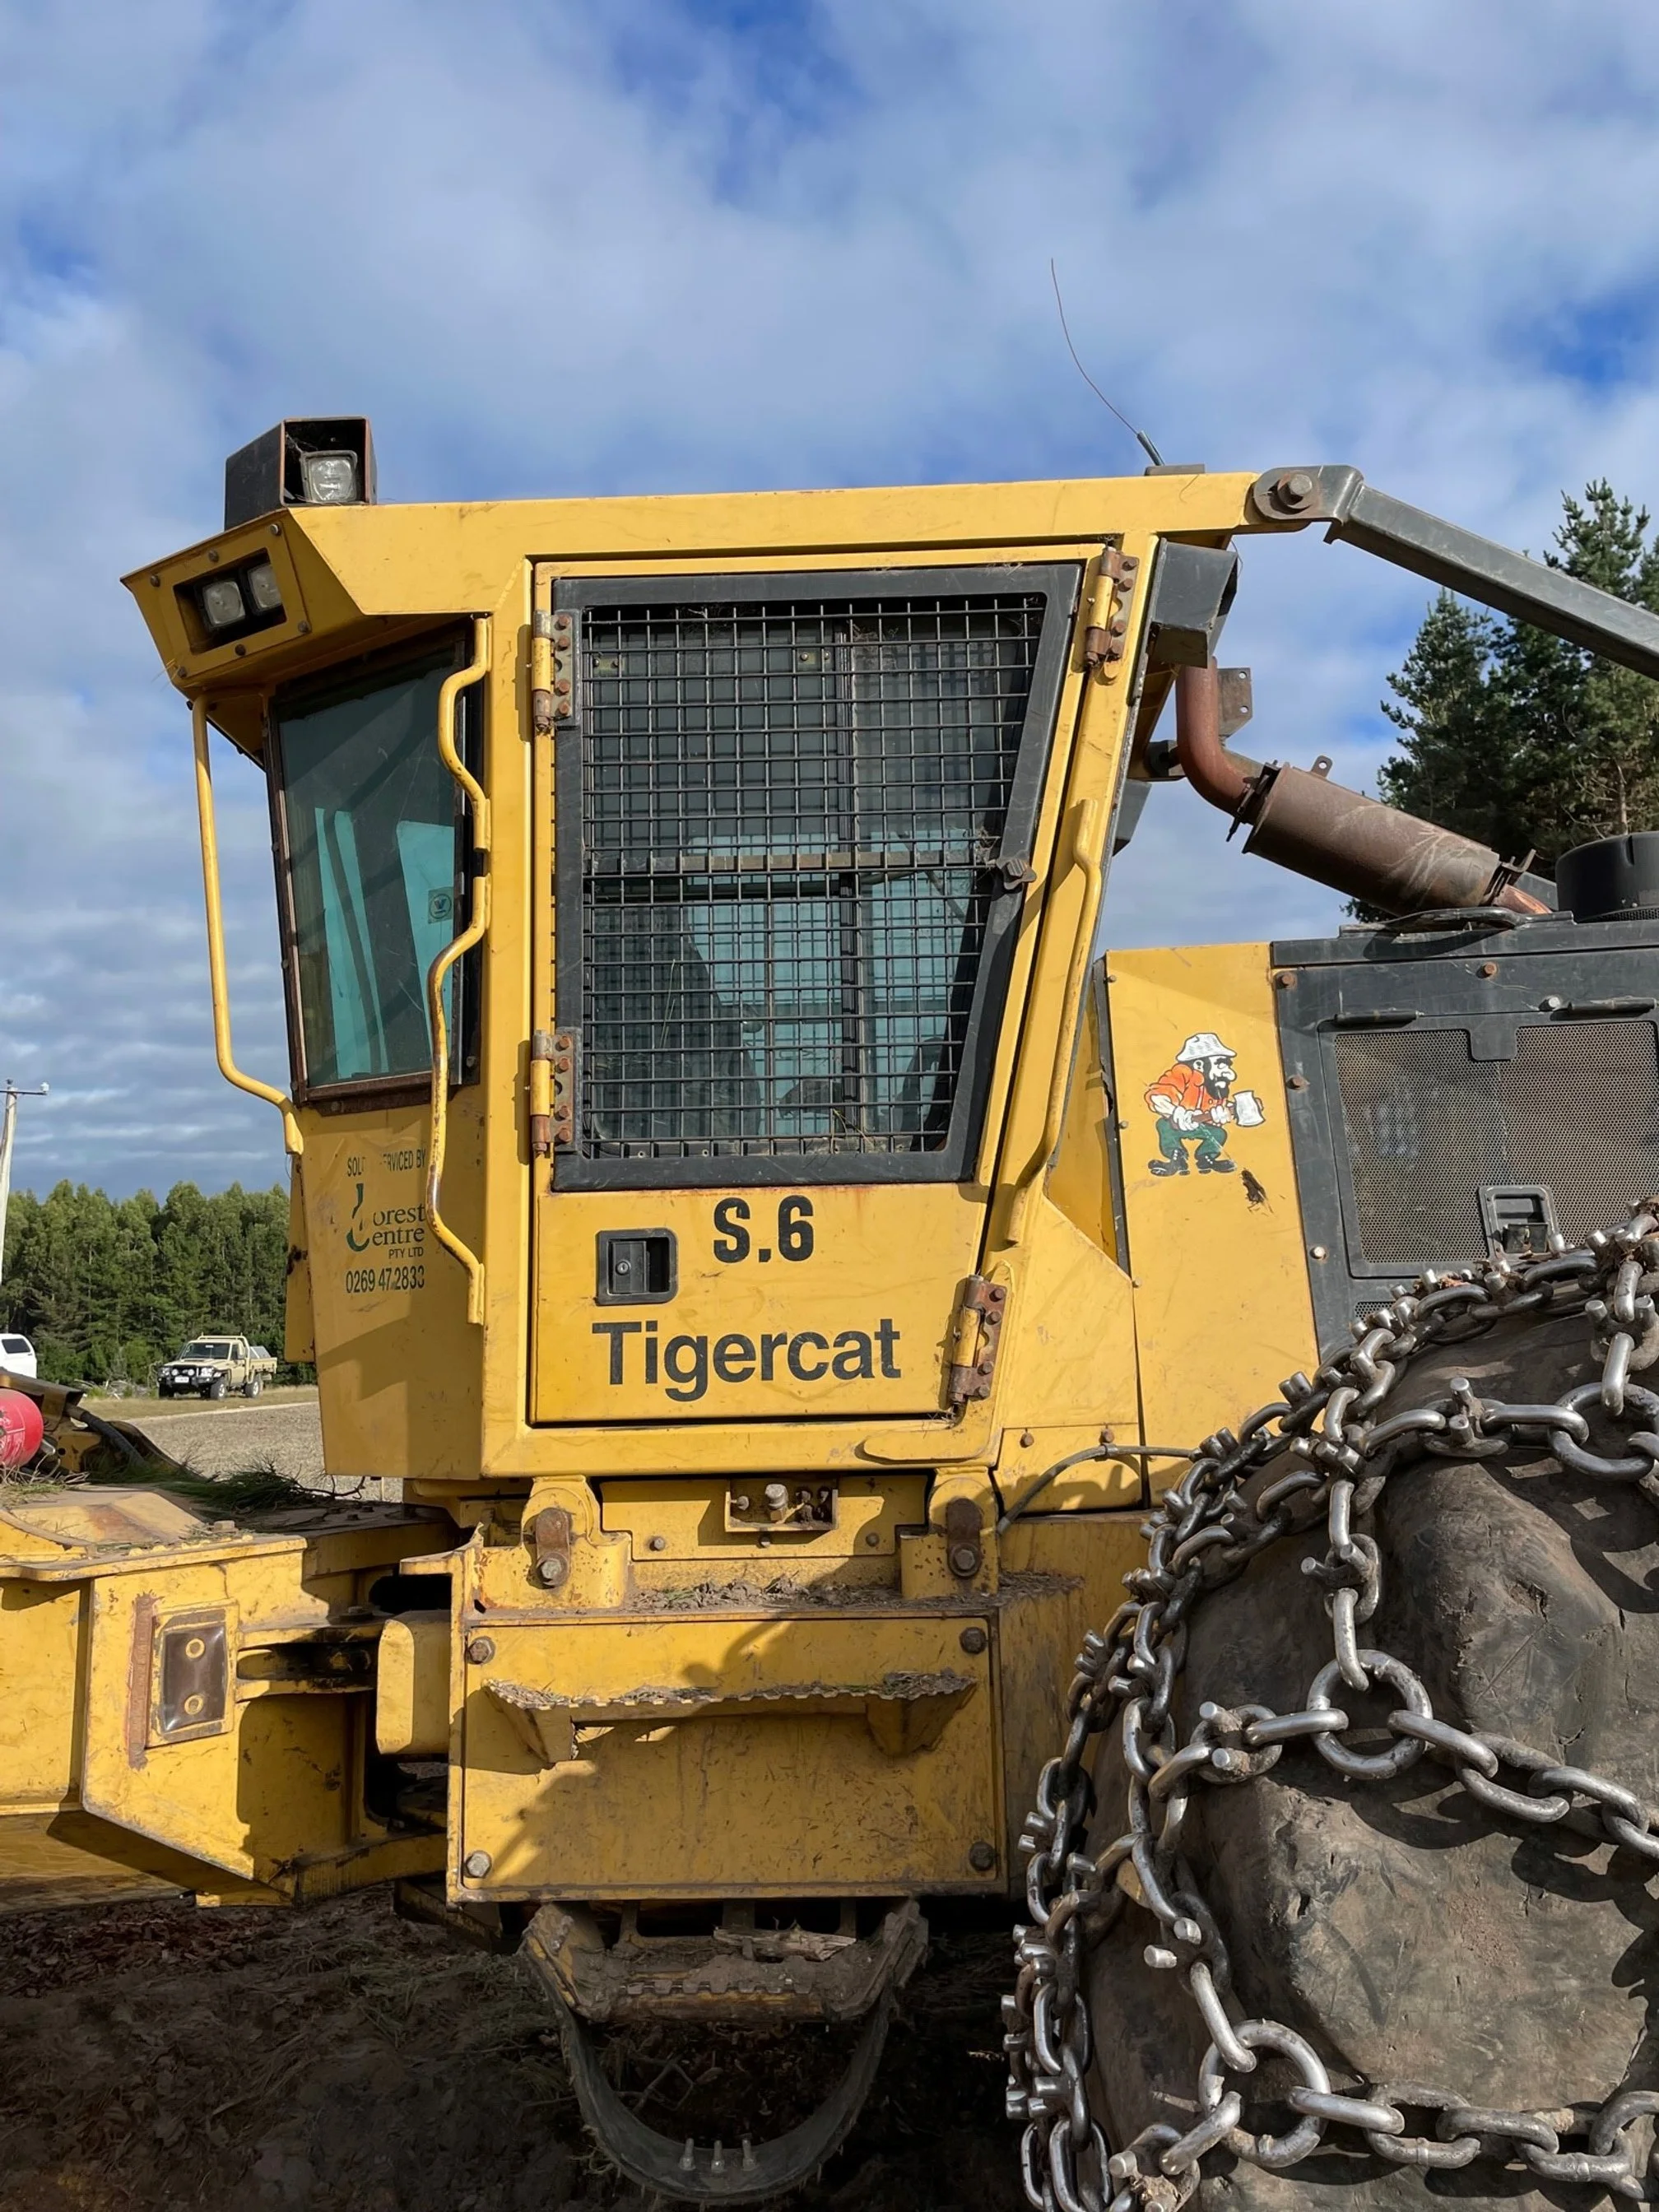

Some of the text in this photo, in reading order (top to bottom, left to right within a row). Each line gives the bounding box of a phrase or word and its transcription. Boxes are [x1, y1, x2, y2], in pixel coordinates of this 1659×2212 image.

[416, 1148, 426, 1168] BY
[713, 1194, 815, 1263] S.6
[388, 1246, 424, 1259] PTY LTD
[346, 1269, 375, 1294] 0269
[592, 1318, 902, 1402] Tigercat
